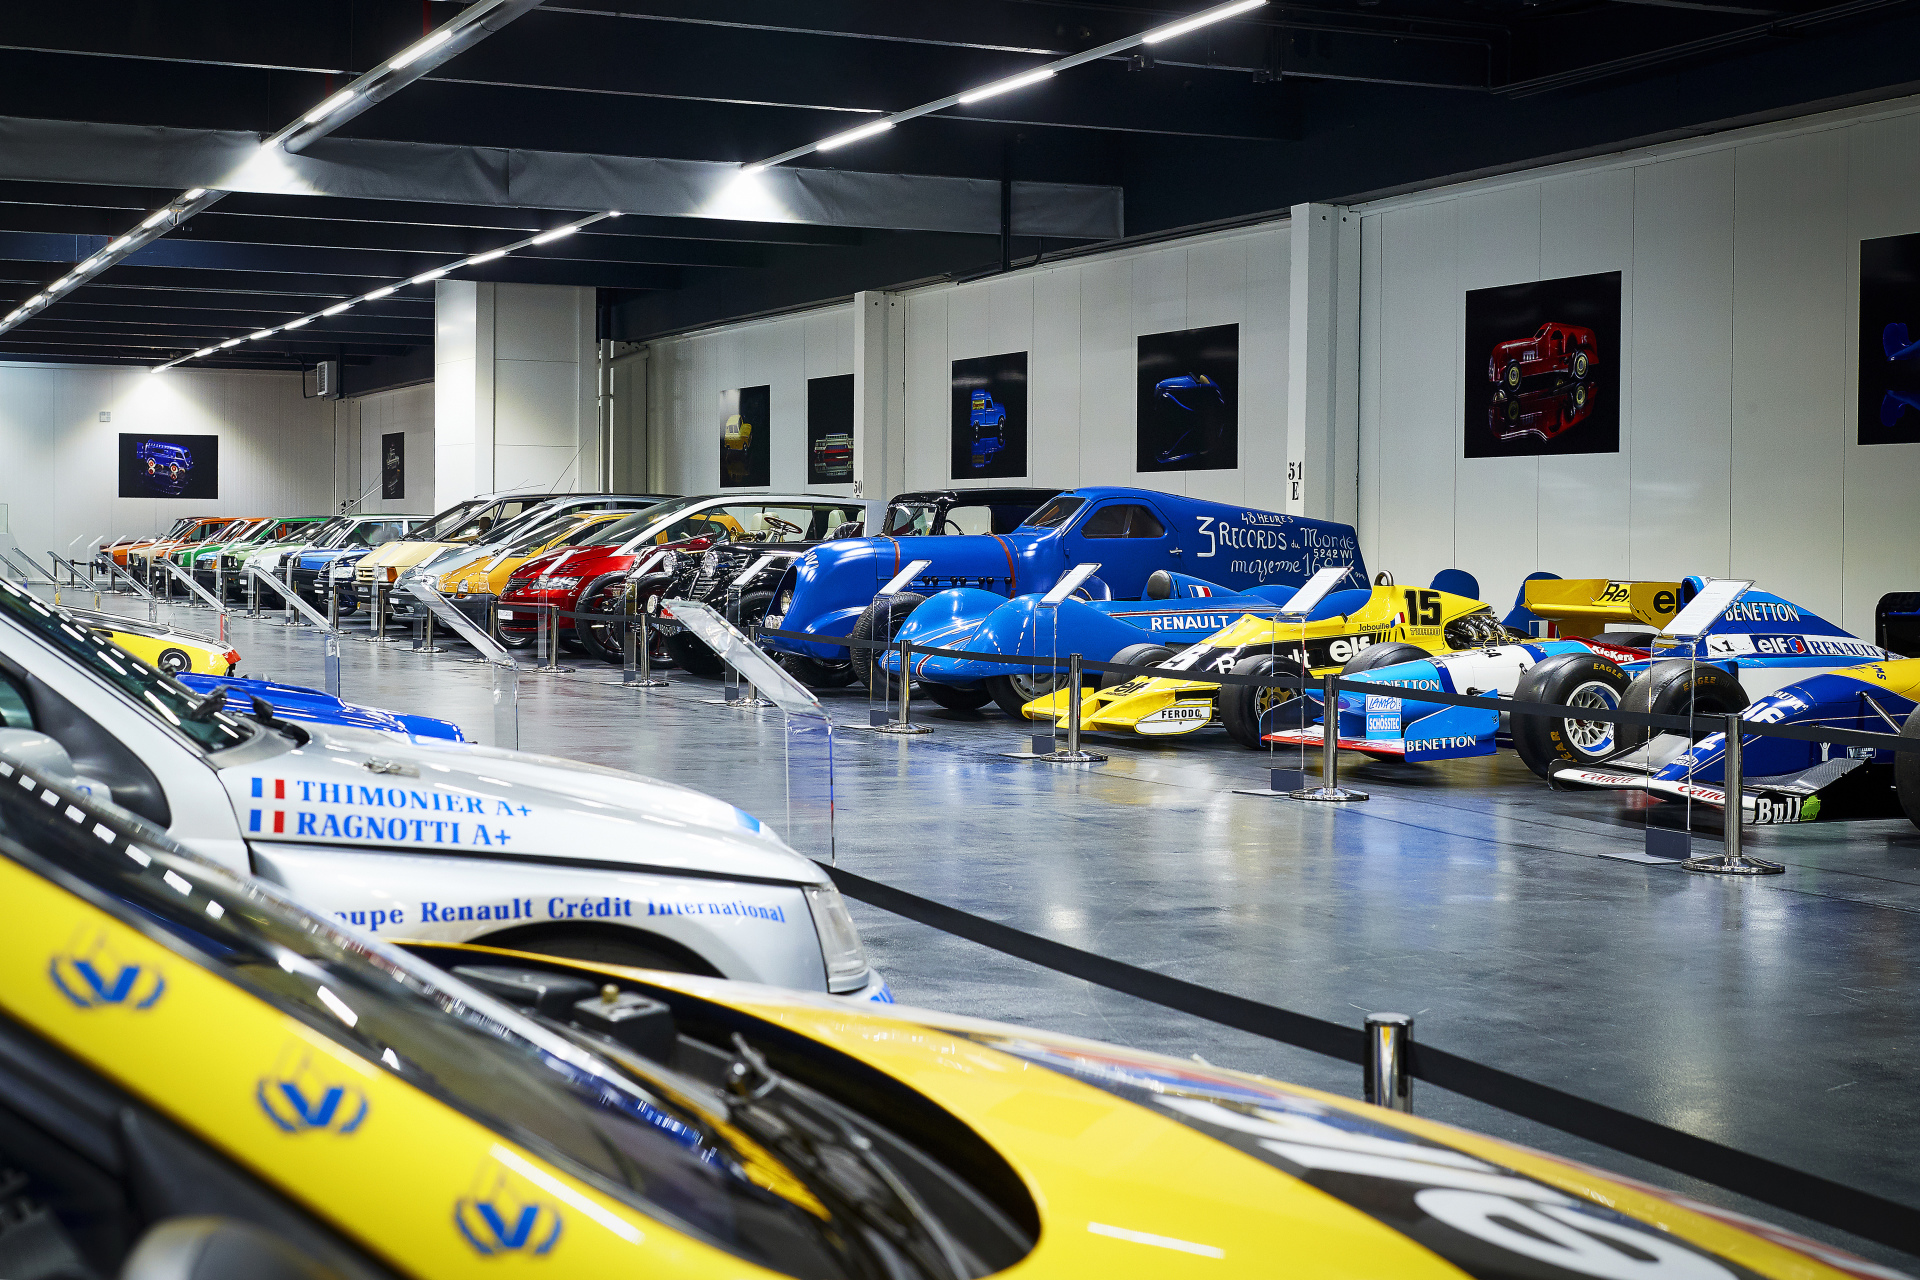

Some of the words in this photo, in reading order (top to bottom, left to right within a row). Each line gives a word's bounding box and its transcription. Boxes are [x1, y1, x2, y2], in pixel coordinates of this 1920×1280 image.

[1288, 461, 1302, 480] 51
[1292, 482, 1299, 500] E
[1241, 512, 1256, 525] 48
[1257, 513, 1294, 525] HEURES
[1196, 516, 1216, 557] 3
[1219, 521, 1287, 551] RECORDS
[1290, 540, 1301, 549] du
[1300, 527, 1356, 550] Monde
[1313, 548, 1338, 559] 5242
[1404, 589, 1442, 627] 15
[1725, 601, 1800, 622] BENETTON
[1151, 615, 1229, 631] RENAULT
[1358, 623, 1390, 632] Jabouille
[1329, 636, 1371, 663] elf
[1758, 637, 1787, 654] elf
[1808, 640, 1881, 657] RENAULT
[1593, 662, 1623, 679] EAGLE
[1683, 676, 1716, 691] EAGLE
[1161, 709, 1201, 719] FERODO
[1406, 735, 1477, 752] BENETTON
[297, 780, 486, 815] THIMONIER
[496, 800, 532, 817] A+
[1678, 786, 1726, 800] Cano
[1756, 798, 1801, 825] Bull
[296, 812, 460, 844] RAGNOTTI
[472, 824, 512, 846] A+
[335, 907, 404, 932] oupe
[421, 898, 533, 923] Renault
[548, 897, 632, 919] Crédit
[648, 899, 786, 923] International
